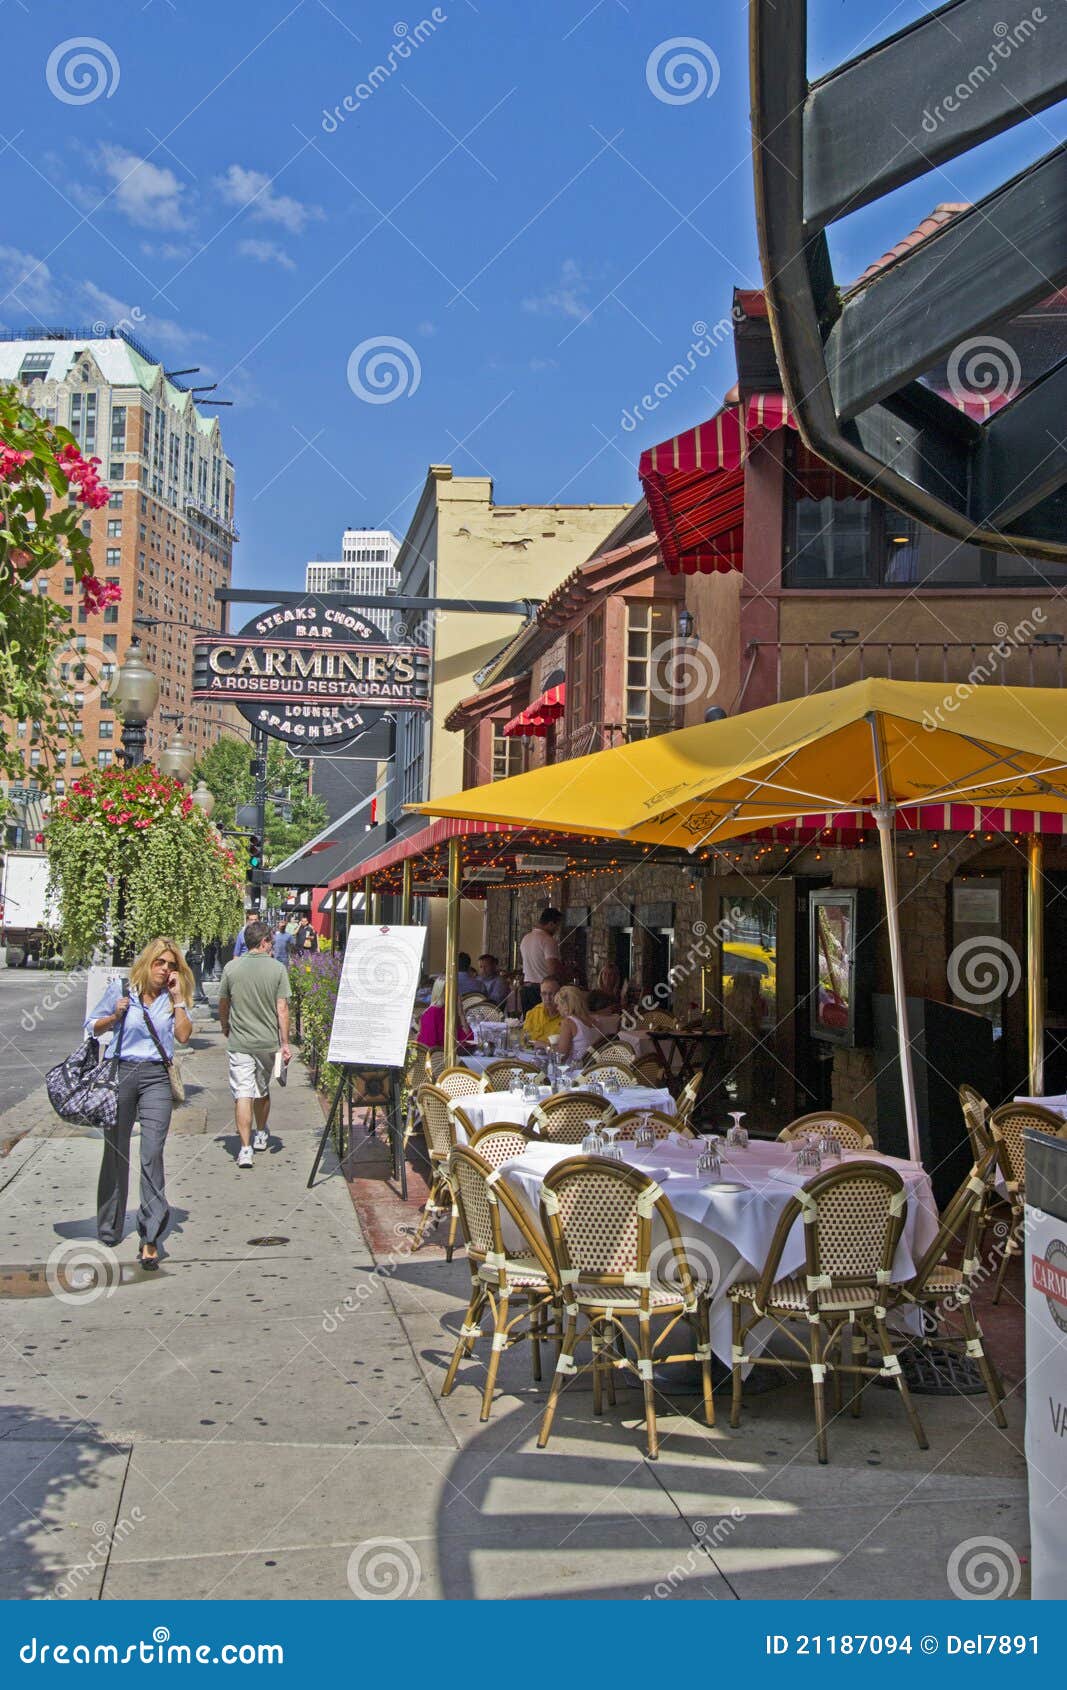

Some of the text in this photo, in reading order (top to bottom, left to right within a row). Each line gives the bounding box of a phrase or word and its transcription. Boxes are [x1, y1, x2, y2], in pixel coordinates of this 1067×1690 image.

[255, 607, 373, 639] STEAKS CHOPS
[295, 625, 333, 638] BAR
[208, 645, 415, 683] CARMINE'S
[210, 676, 413, 697] A ROSEBUD RESTAURANT
[257, 709, 364, 737] SPAGHETTI
[285, 705, 339, 718] LOUNGE
